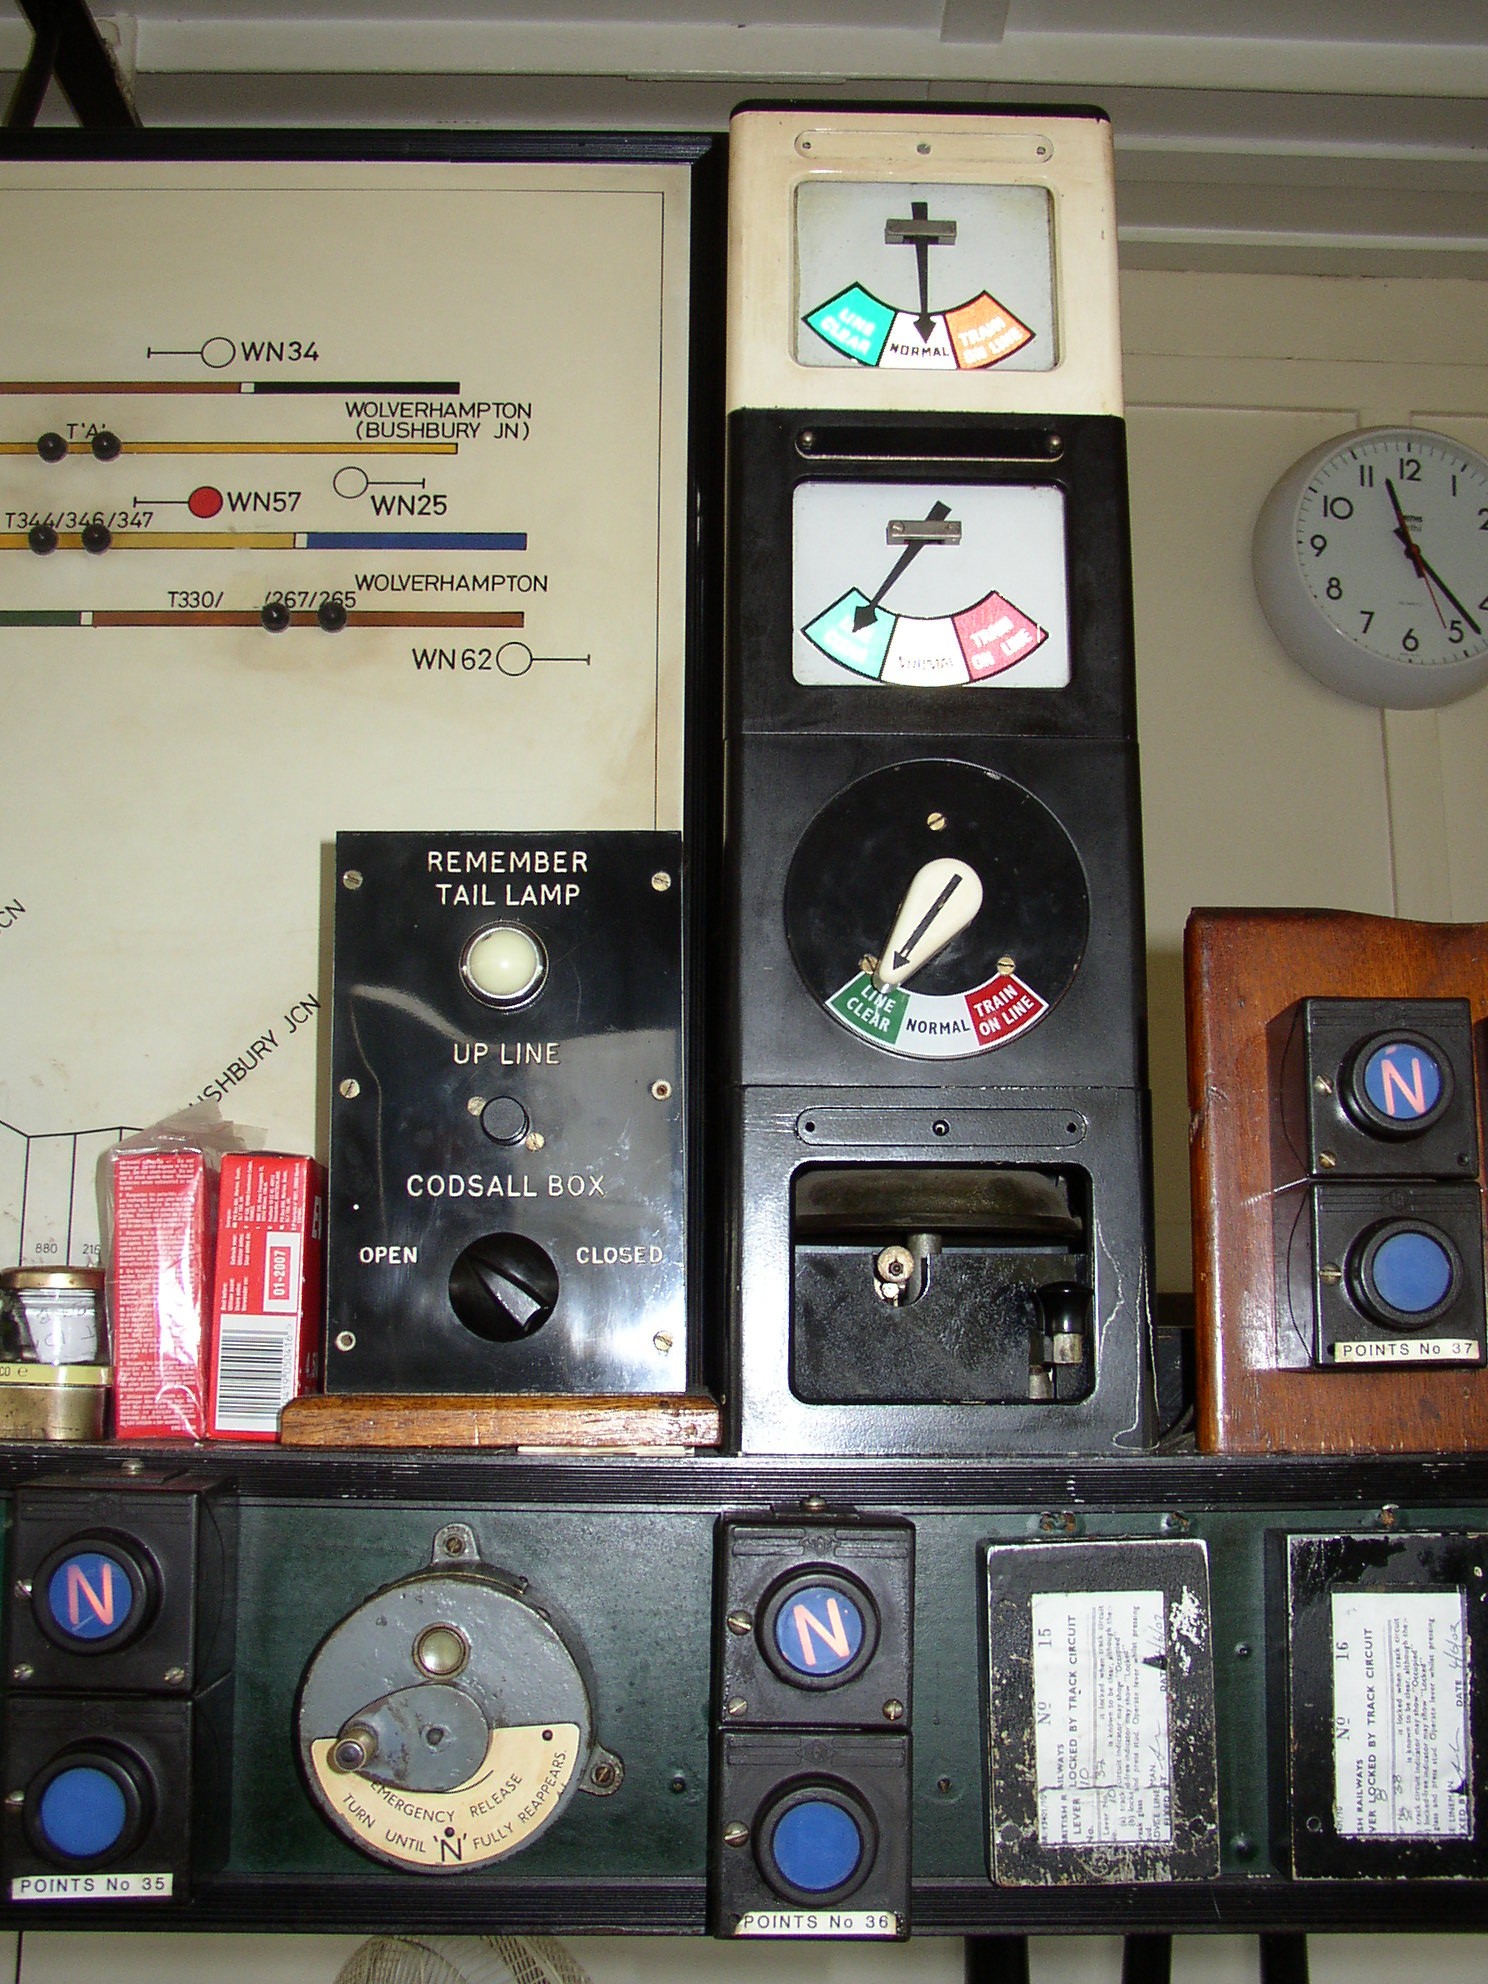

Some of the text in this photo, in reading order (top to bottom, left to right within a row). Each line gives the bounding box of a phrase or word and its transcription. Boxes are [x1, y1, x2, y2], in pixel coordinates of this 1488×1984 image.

[957, 316, 1007, 348] TRAIN
[242, 341, 319, 362] WN34
[889, 342, 950, 358] NORMAL
[345, 401, 532, 419] WOLVERHAMPTON
[355, 421, 530, 441] (BUSHBURY JN)
[1360, 464, 1374, 487] 11
[1400, 458, 1422, 482] 12
[1452, 475, 1457, 497] 1
[227, 491, 302, 513] WN57
[370, 495, 447, 516] WN25
[1324, 495, 1354, 520] 10
[5, 511, 154, 530] T344/346/347
[1310, 534, 1327, 557] 9
[355, 574, 548, 593] WOLVERHAMPTON
[1326, 577, 1343, 600] 8
[168, 591, 225, 609] T330/
[1360, 610, 1375, 634] 7
[1448, 620, 1464, 644] 5
[1402, 628, 1419, 652] 6
[427, 851, 589, 874] REMEMBER
[435, 884, 580, 907] TAIL LAMP
[0, 898, 26, 934] CN
[861, 984, 897, 1014] LINE
[973, 984, 1019, 1018] TRAIN
[846, 997, 891, 1032] CLEAR
[978, 995, 1035, 1037] ON LINE
[906, 1018, 970, 1035] NORMAL
[188, 993, 321, 1106] SHBURY JCN
[453, 1043, 561, 1065] UP LINE
[1381, 1057, 1426, 1115] N
[406, 1174, 606, 1198] CODSALL BOX
[35, 1243, 58, 1254] 880
[359, 1246, 418, 1265] OPEN
[576, 1246, 663, 1265] CLOSED
[272, 1250, 286, 1296] 01-2007
[1342, 1342, 1473, 1358] POINTS No 37
[67, 1563, 113, 1626] N
[793, 1597, 850, 1667] N
[1038, 1628, 1052, 1647] 15
[1068, 1615, 1077, 1664] CIRCUIT
[1336, 1642, 1349, 1660] 16
[1364, 1628, 1374, 1678] CIRCUIT
[1366, 1686, 1375, 1724] TRACK
[1455, 1680, 1463, 1707] DATE
[1069, 1717, 1077, 1731] BY
[1368, 1733, 1376, 1747] BY
[1069, 1739, 1077, 1787] LOCKED
[1356, 1760, 1364, 1812] RAILWAYS
[1368, 1755, 1376, 1803] LOCKED
[342, 1750, 566, 1863] TURN UNTIL 'N' FULLY REAPPEARS
[370, 1772, 523, 1823] EMERGENCY RELEASE
[1073, 1798, 1082, 1834] LEVER
[20, 1876, 166, 1895] POINTS No 35
[744, 1914, 889, 1930] POINTS No 36
